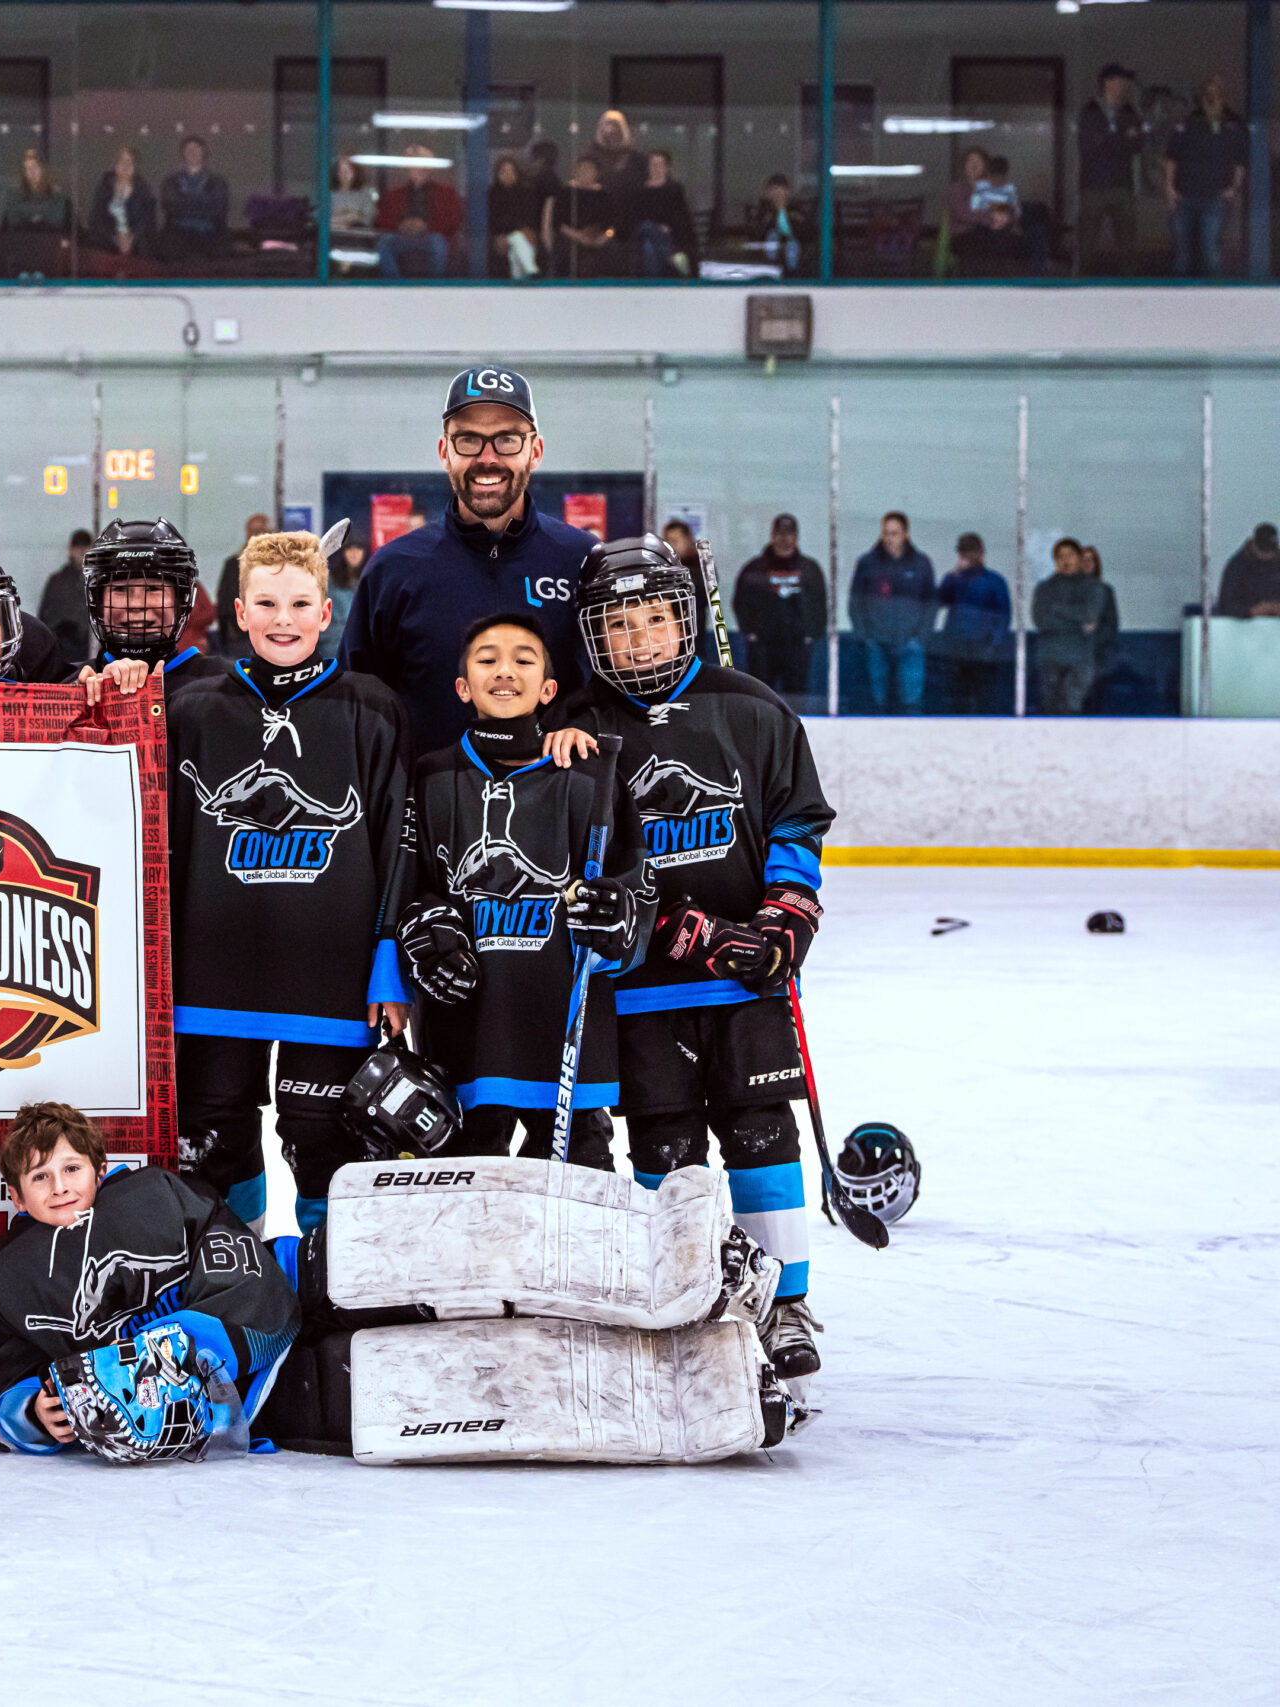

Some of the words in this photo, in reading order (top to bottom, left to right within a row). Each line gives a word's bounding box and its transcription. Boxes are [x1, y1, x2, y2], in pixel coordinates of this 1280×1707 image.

[466, 369, 515, 397] LGS
[116, 550, 155, 558] BAUER
[524, 576, 571, 608] LGS
[272, 661, 324, 686] CCM
[654, 856, 677, 868] Leslie
[678, 851, 701, 862] Global
[703, 847, 726, 858] Sports
[242, 871, 263, 882] Leslie
[264, 870, 288, 880] Global
[289, 870, 315, 881] Sports
[497, 937, 517, 948] Global
[517, 937, 542, 950] Sports
[748, 1067, 801, 1086] ITECH
[158, 1107, 171, 1153] MADNESS
[373, 1171, 476, 1187] BAUER
[200, 1232, 262, 1278] 61
[400, 1419, 506, 1437] BAUER
